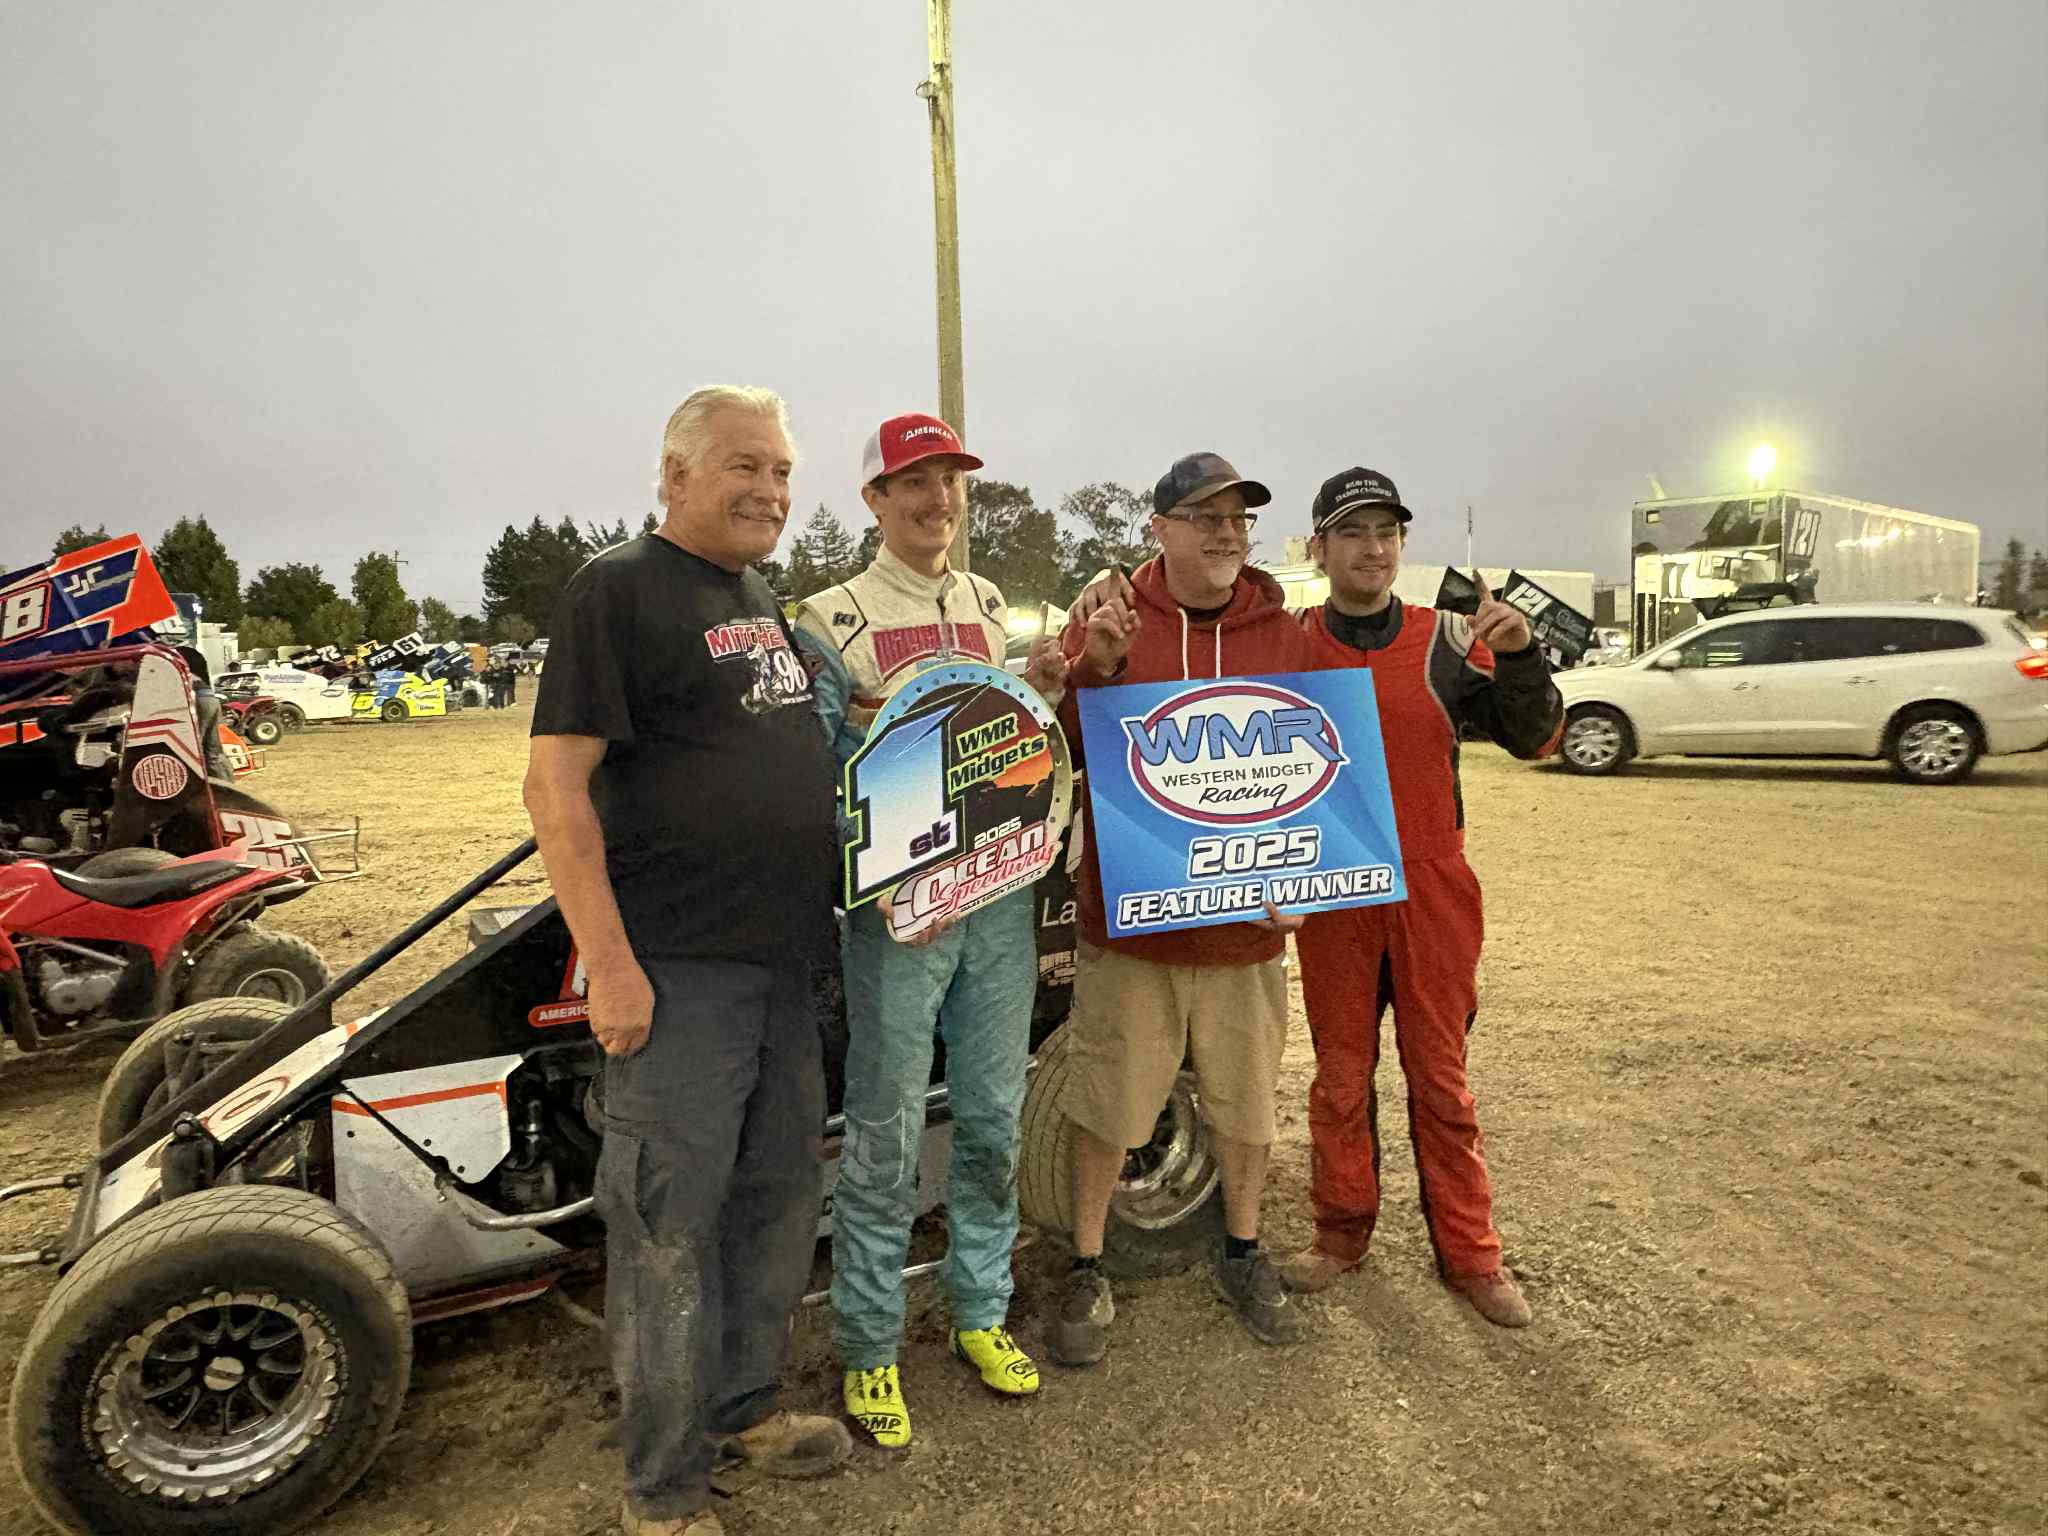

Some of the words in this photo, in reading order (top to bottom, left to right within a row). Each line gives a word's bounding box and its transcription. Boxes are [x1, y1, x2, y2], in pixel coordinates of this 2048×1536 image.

[959, 716, 1015, 755] WMR
[1126, 706, 1345, 767] WMR
[950, 737, 1045, 791] Midgets
[1162, 772, 1246, 788] WESTERN
[1251, 762, 1314, 780] MIDGET
[1199, 783, 1288, 807] Racing
[974, 817, 1022, 848] 2025
[1190, 829, 1319, 877] 2025
[1119, 883, 1264, 925] FEATURE
[1271, 868, 1392, 904] WINNER
